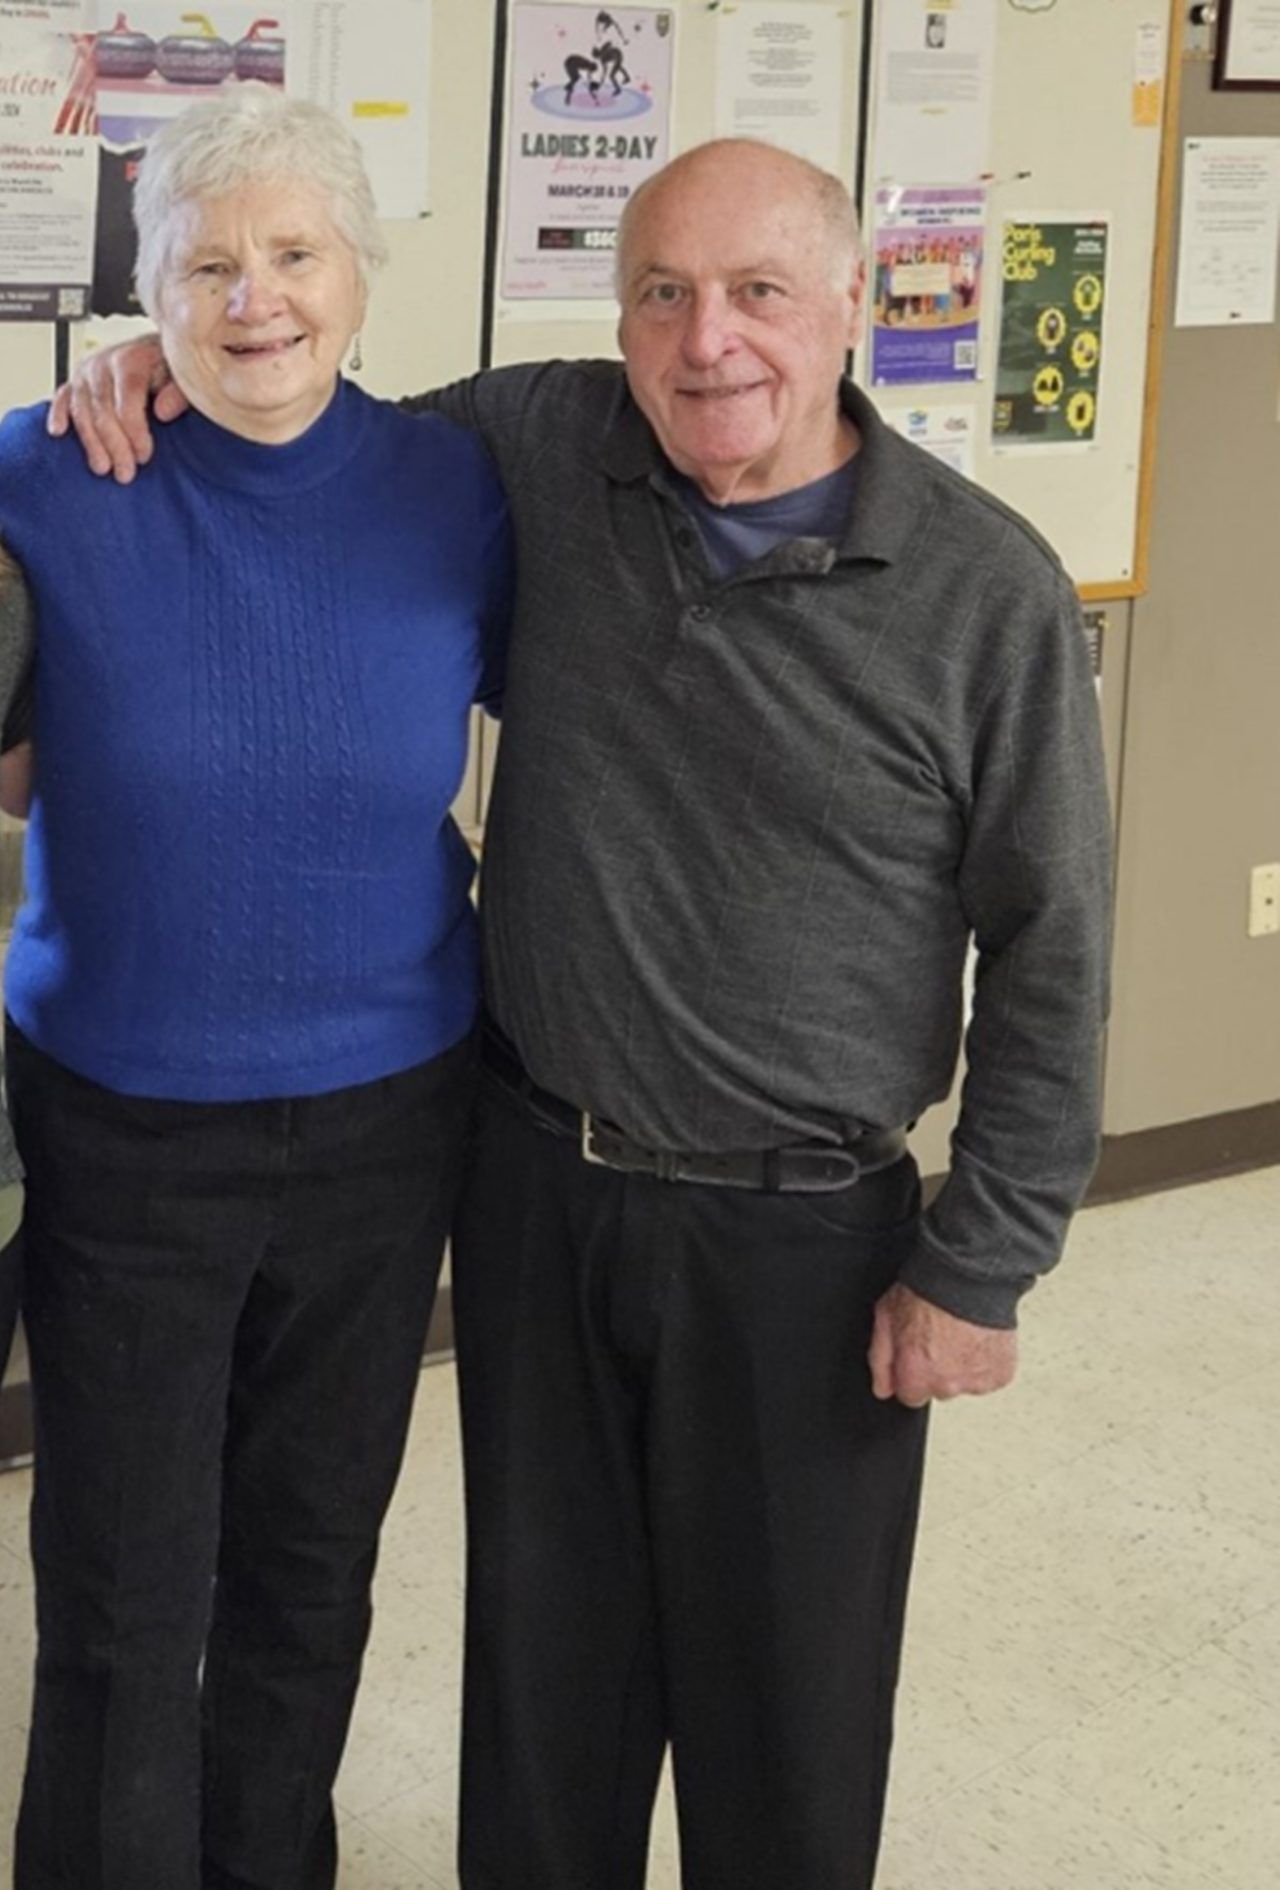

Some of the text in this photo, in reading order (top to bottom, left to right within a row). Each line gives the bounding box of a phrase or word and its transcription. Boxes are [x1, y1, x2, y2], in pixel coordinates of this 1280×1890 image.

[65, 147, 84, 157] and
[521, 133, 658, 159] LADIES 2-DAY
[548, 184, 591, 197] MARCH
[1002, 242, 1056, 267] Curling
[1002, 262, 1038, 281] Club
